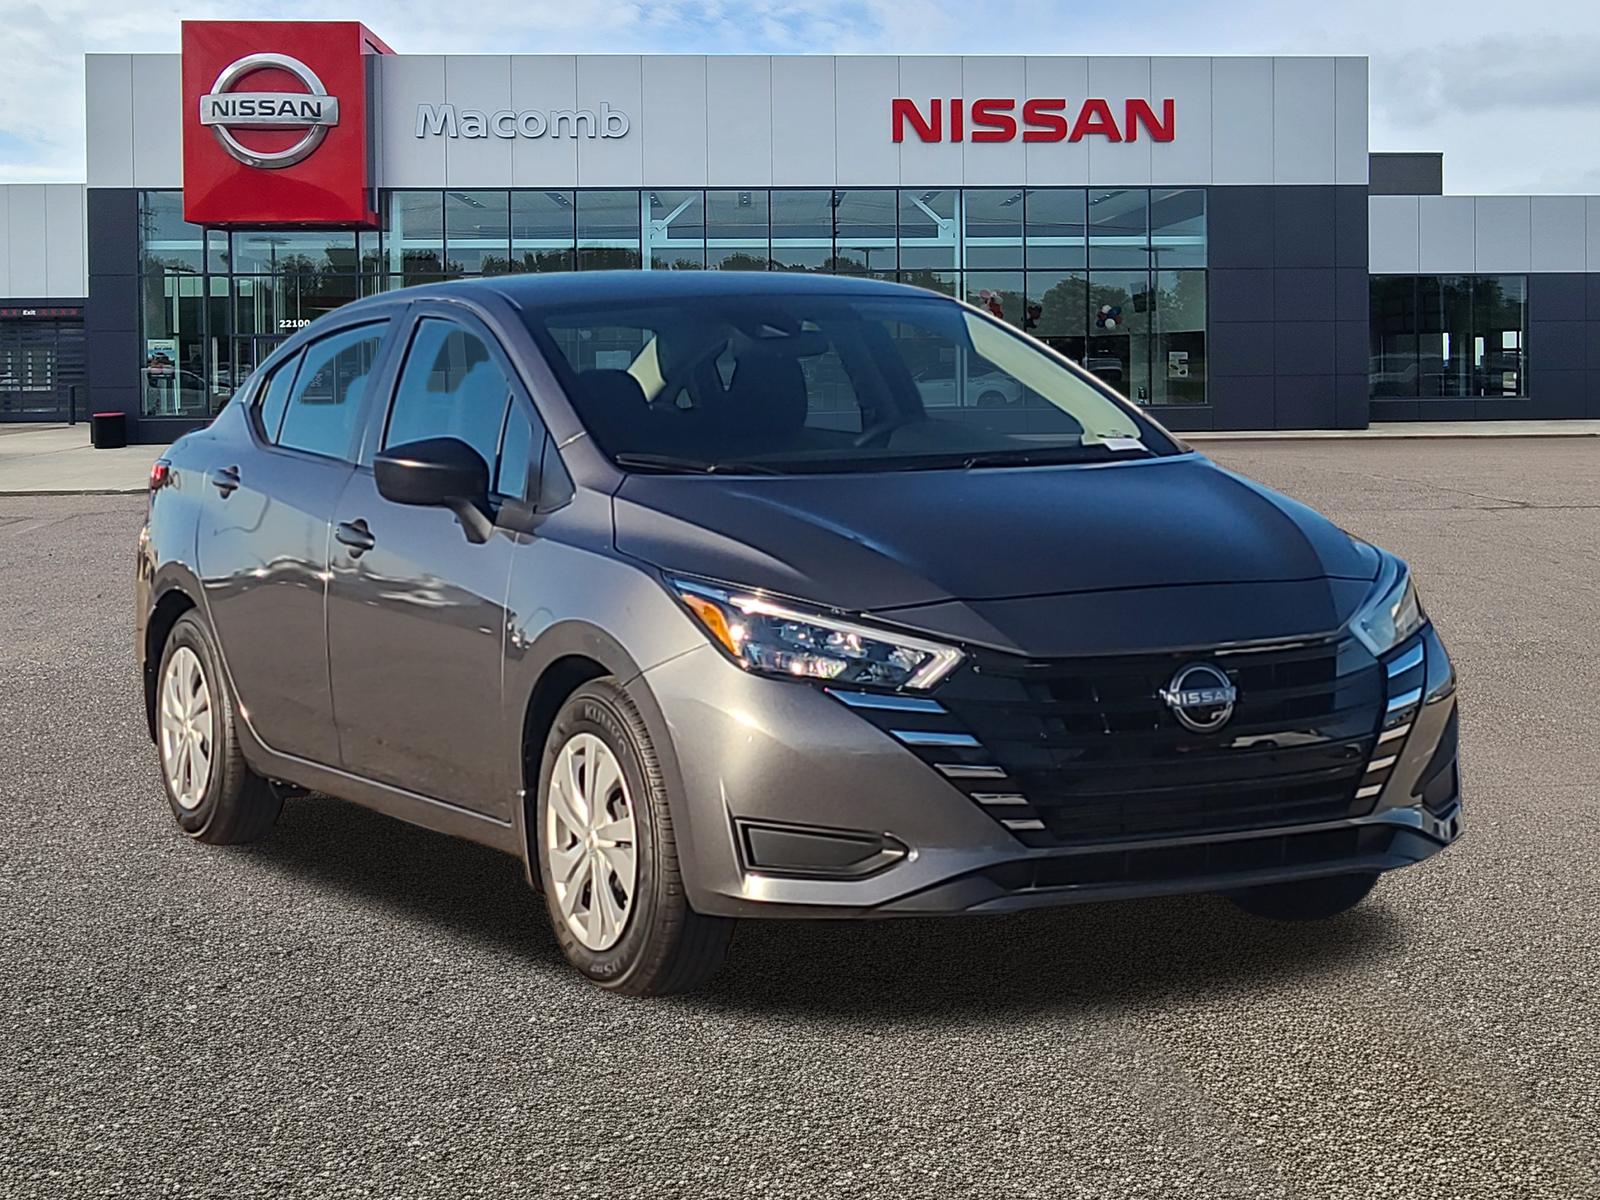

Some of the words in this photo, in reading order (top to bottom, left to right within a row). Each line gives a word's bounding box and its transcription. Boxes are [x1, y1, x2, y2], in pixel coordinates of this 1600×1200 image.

[212, 100, 322, 118] NISSAN
[415, 102, 630, 139] Macomb
[892, 98, 1175, 143] NISSAN
[279, 319, 311, 328] 22100
[1167, 690, 1235, 706] NISSAN
